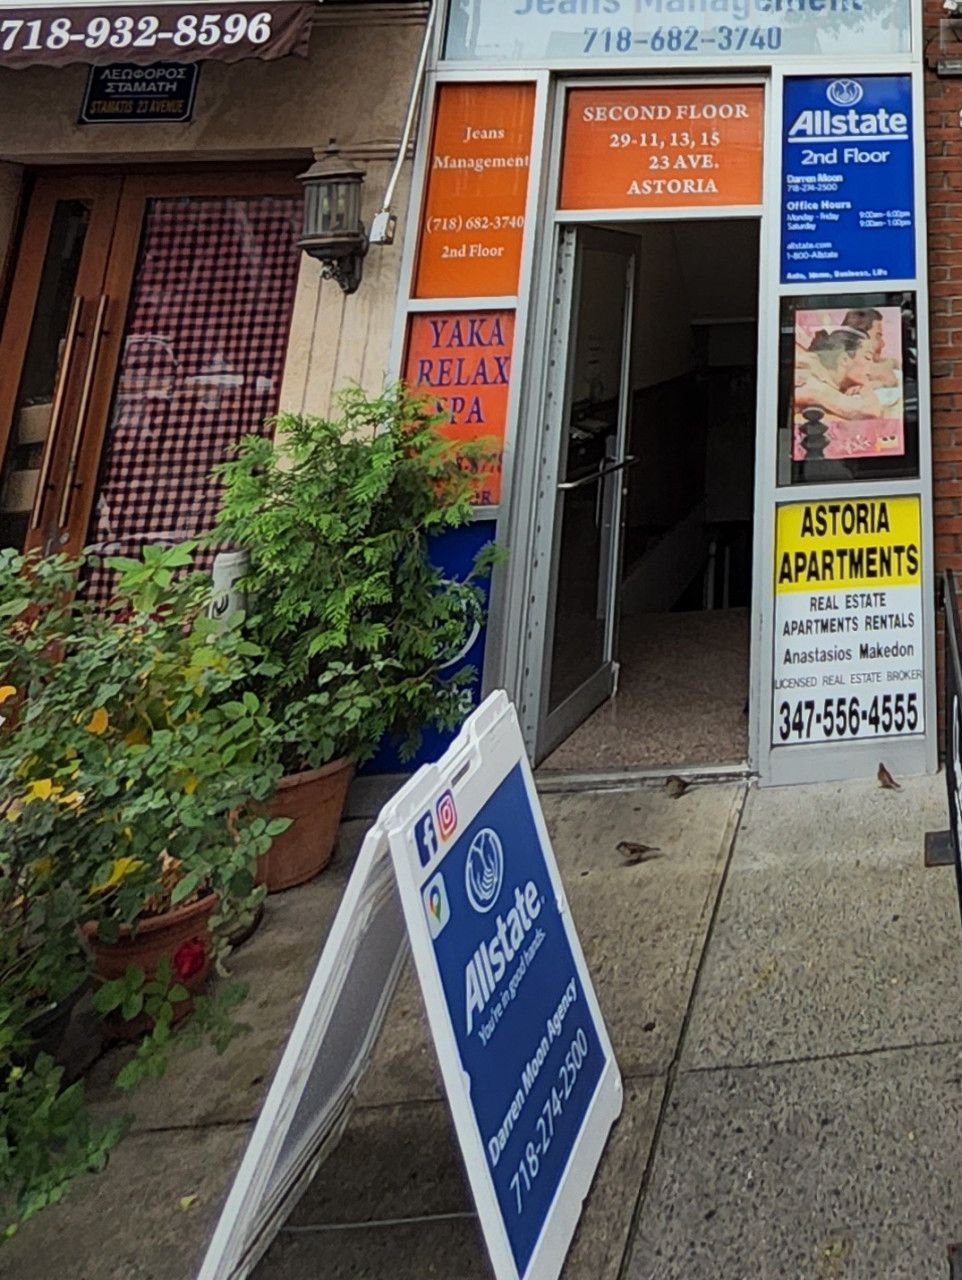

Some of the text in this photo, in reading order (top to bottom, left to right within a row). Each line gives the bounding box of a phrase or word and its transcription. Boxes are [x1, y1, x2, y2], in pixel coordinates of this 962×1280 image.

[1, 12, 272, 51] 718-932-8596
[583, 25, 782, 53] 718-682-3740
[583, 103, 750, 122] SECOND FLOOR
[788, 107, 908, 137] Allstate
[463, 127, 505, 143] Jeans
[609, 131, 721, 150] 29-11, 13, 15
[433, 155, 530, 172] Management
[648, 154, 720, 170] 23 AVE.
[801, 147, 891, 165] 2nd Floor
[627, 178, 719, 195] ASTORIA
[786, 200, 852, 211] Office Hours
[426, 215, 525, 234] (718) 682-3740
[441, 244, 505, 259] 2nd Floor
[431, 317, 505, 349] YAKA
[417, 355, 512, 388] RELAX
[801, 502, 890, 538] ASTORIA
[778, 543, 919, 585] APARTMENTS
[810, 592, 887, 612] REAL ESTATE
[783, 612, 915, 637] APARTMENTS RENTALS
[783, 640, 914, 665] Anastasios Makedon
[775, 669, 923, 690] LICENSED REAL ESTATE BROKER
[779, 692, 919, 741] 347-556-4555
[466, 880, 541, 1036] Allstate
[488, 976, 578, 1168] Darren Moon Agency
[510, 1026, 588, 1216] 718-274-2500
